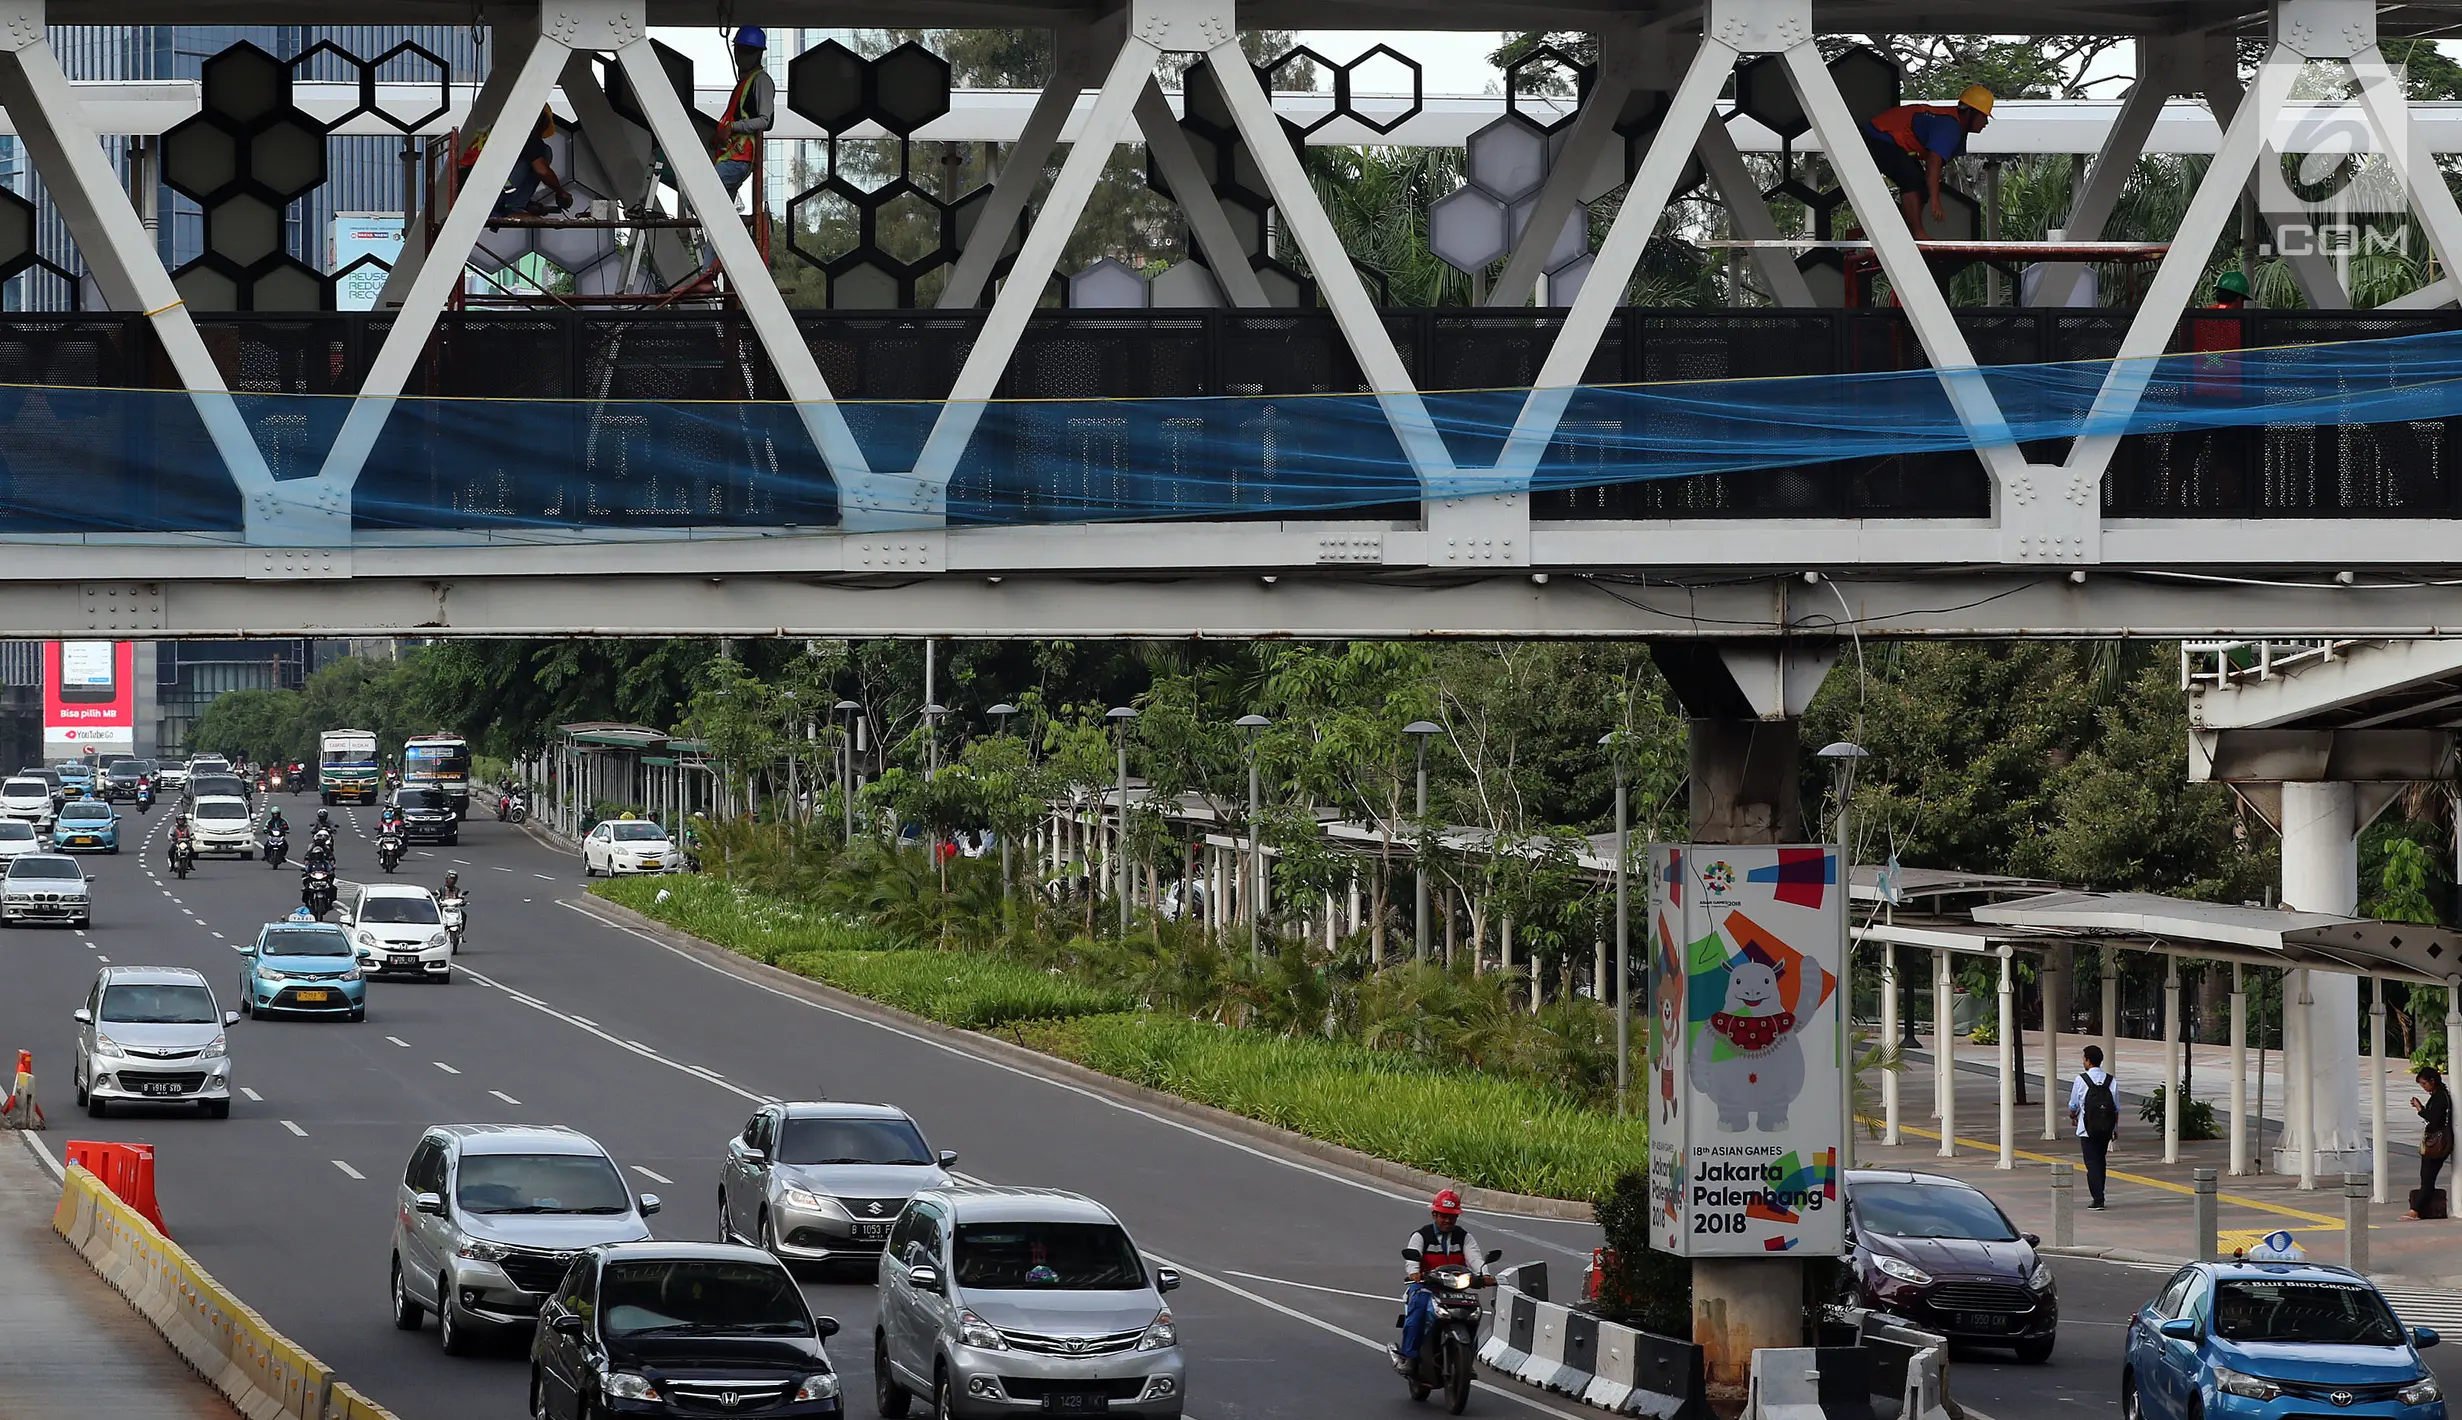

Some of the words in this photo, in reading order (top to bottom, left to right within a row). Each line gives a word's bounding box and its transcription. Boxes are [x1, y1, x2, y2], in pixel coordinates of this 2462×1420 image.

[349, 272, 387, 280] REUSE
[60, 709, 79, 718] Bisa
[81, 709, 101, 719] pilih
[103, 710, 117, 718] MB
[1693, 1146, 1710, 1156] 18th
[1711, 1146, 1743, 1155] ASIAN
[1745, 1146, 1782, 1156] GAMES
[1693, 1161, 1783, 1181] Jakarta
[1693, 1186, 1823, 1211] Palembang
[1652, 1206, 1666, 1228] 2018
[1693, 1213, 1747, 1234] 2018
[852, 1224, 857, 1234] B
[863, 1224, 881, 1234] 1053
[2260, 1252, 2297, 1260] TAKSI
[2318, 1283, 2362, 1292] GROUP
[1043, 1395, 1050, 1408] B
[1060, 1395, 1083, 1407] 1429
